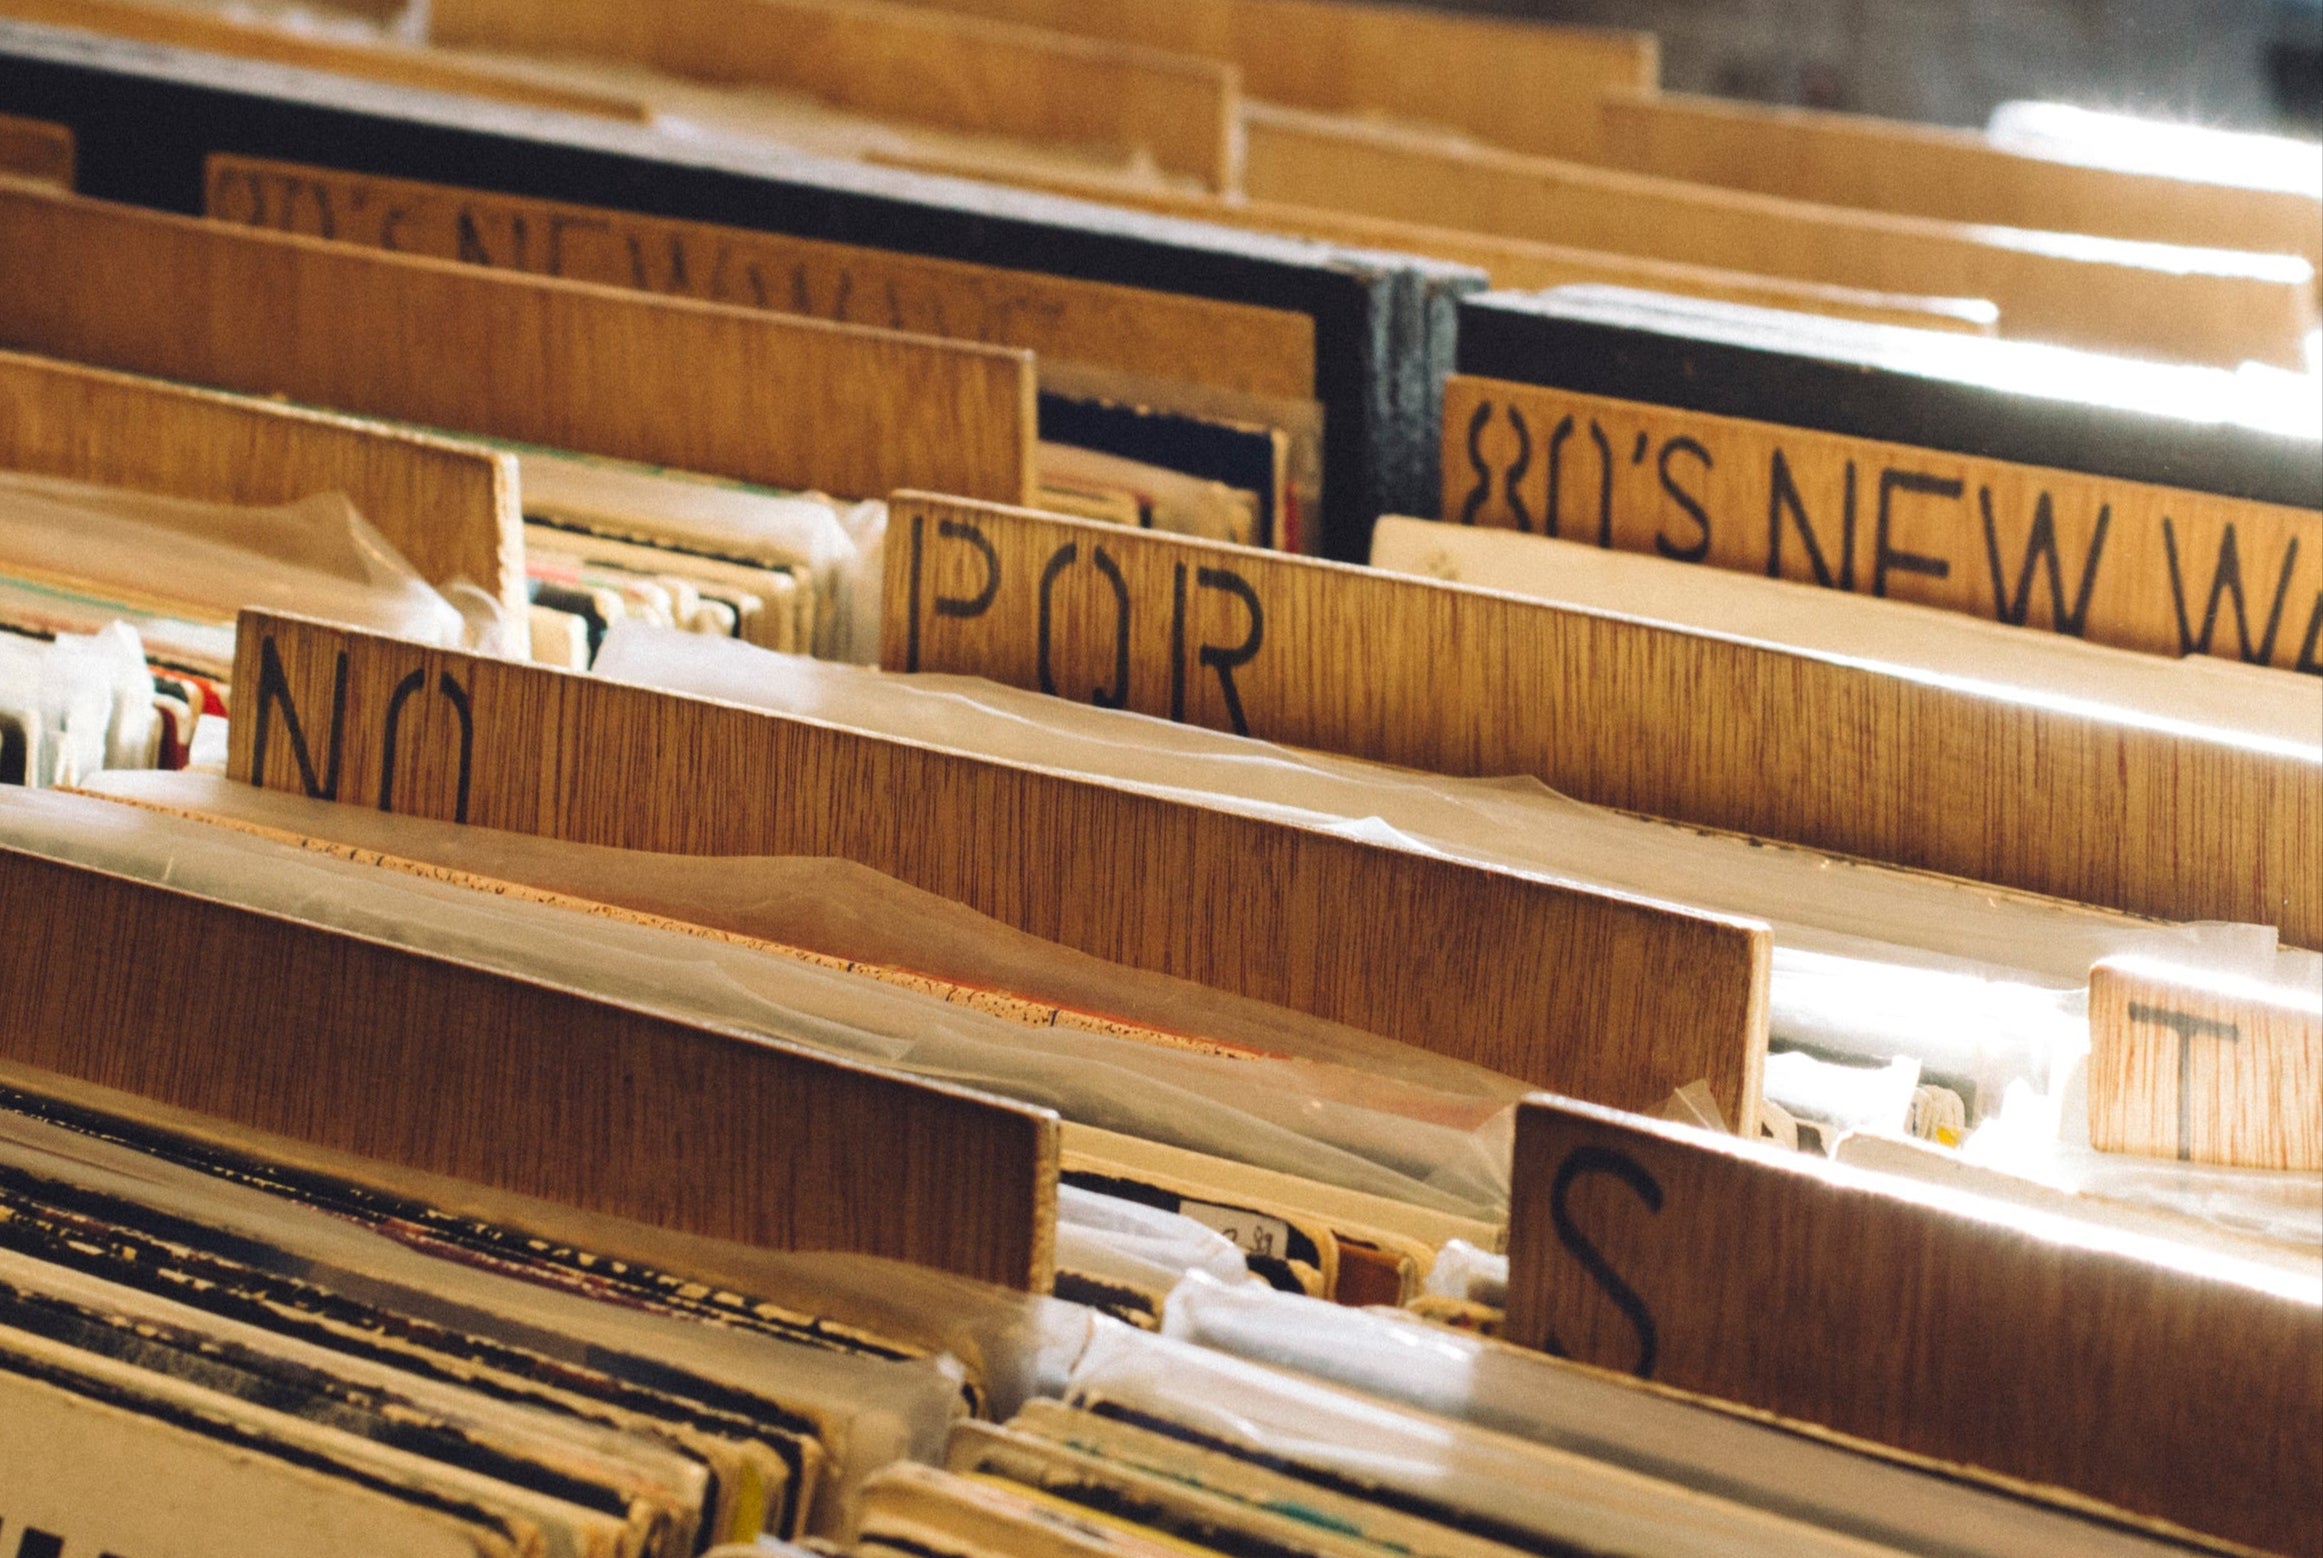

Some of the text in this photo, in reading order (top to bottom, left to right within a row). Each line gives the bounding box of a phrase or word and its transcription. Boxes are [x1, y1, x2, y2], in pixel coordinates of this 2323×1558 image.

[1461, 401, 1713, 564] 80'S
[1766, 447, 2110, 639] NEW
[2128, 1001, 2240, 1162] T
[1544, 1146, 1664, 1380] S
